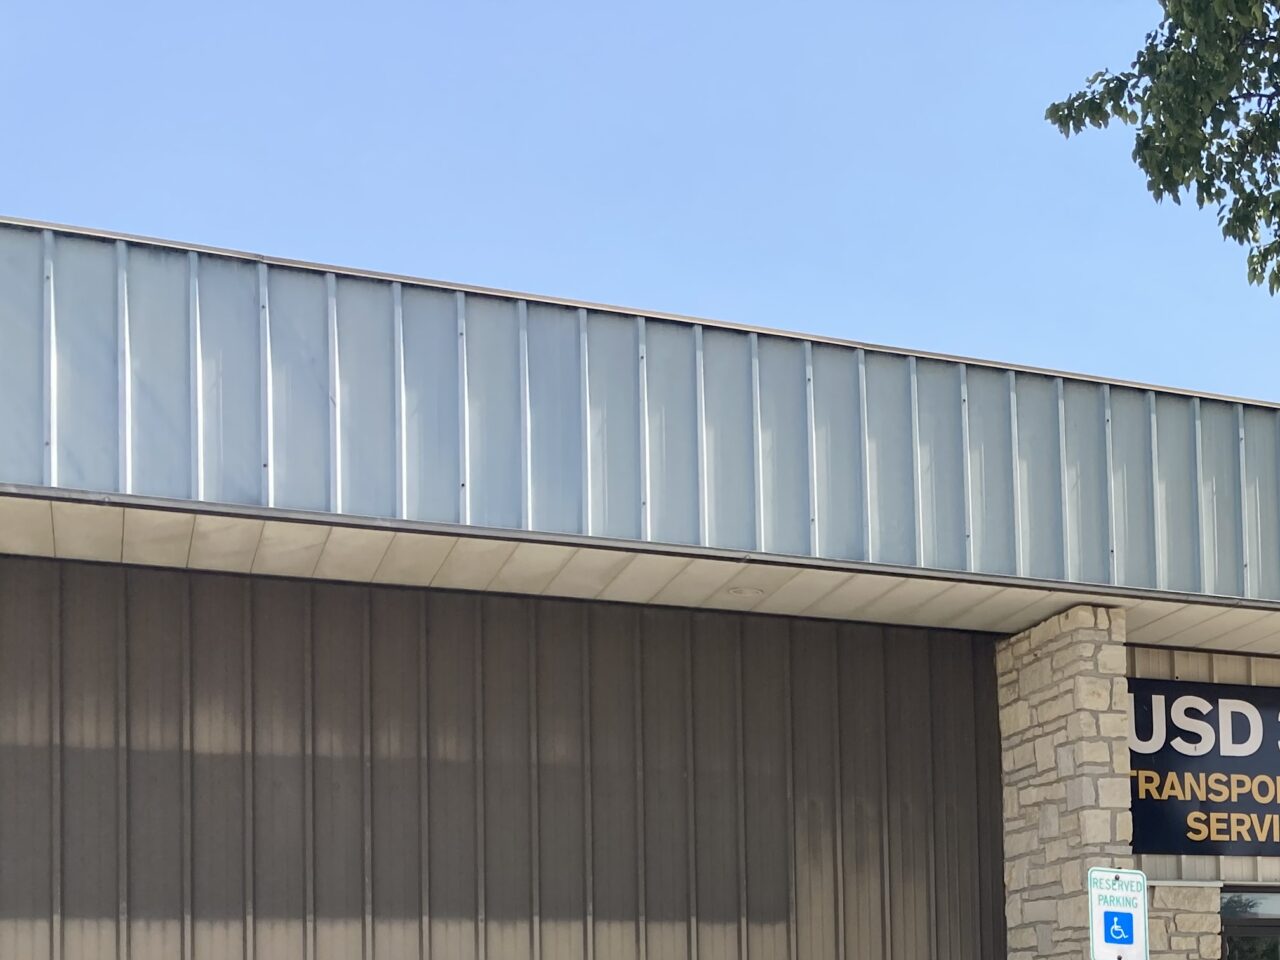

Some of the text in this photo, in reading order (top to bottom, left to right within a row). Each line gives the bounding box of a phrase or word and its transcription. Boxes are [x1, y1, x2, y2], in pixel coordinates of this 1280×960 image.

[1128, 693, 1263, 757] USD
[1093, 877, 1143, 893] RESERVED
[1098, 894, 1138, 909] PARKING
